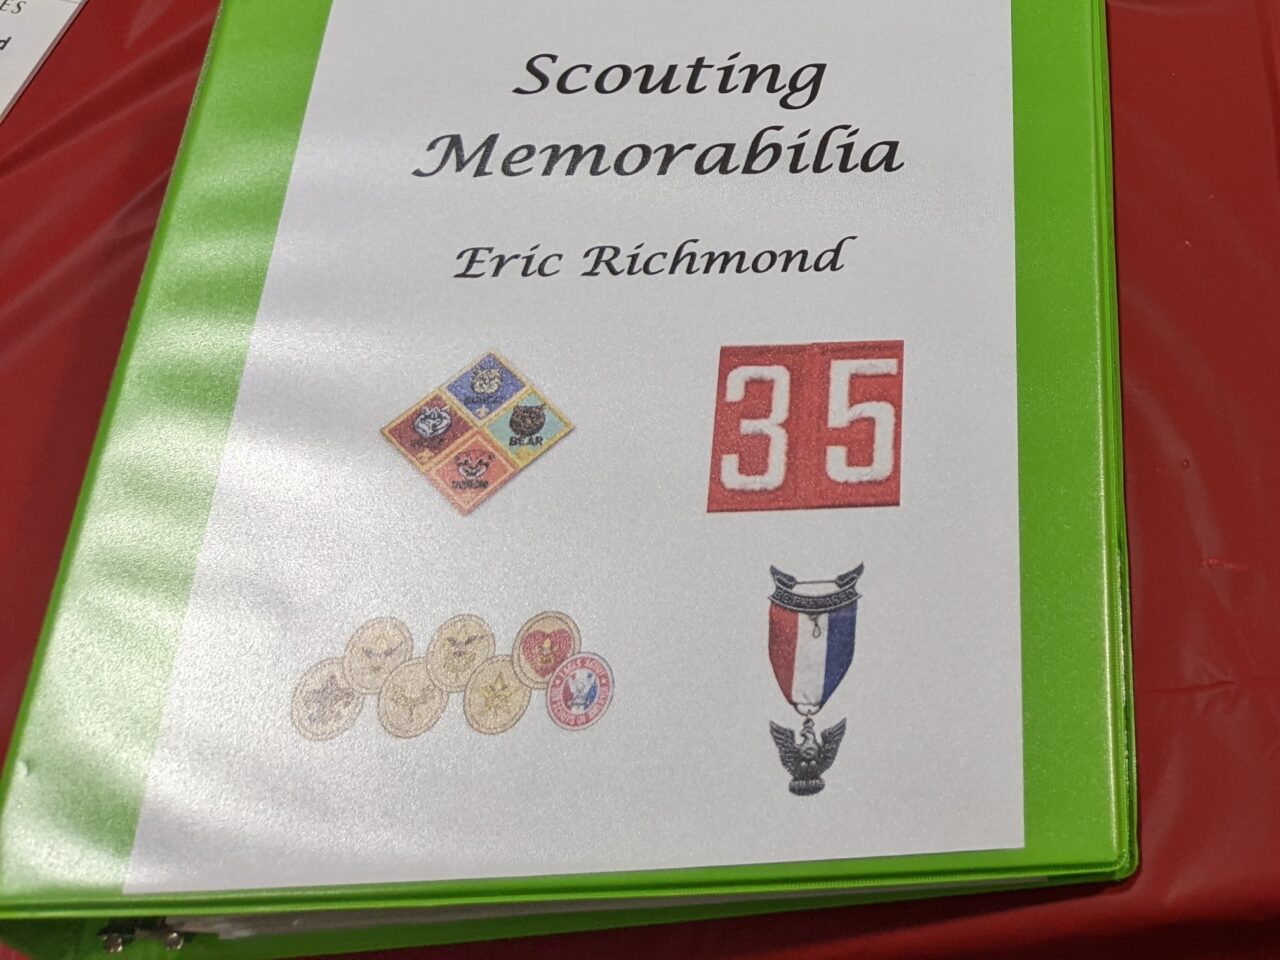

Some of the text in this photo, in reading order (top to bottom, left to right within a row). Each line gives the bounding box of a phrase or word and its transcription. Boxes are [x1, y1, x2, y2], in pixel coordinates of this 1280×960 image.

[512, 51, 828, 111] Scouting
[411, 123, 905, 178] Memorabilia
[453, 235, 858, 279] Eric Richmond
[508, 435, 544, 447] BEAR
[720, 357, 899, 492] 35
